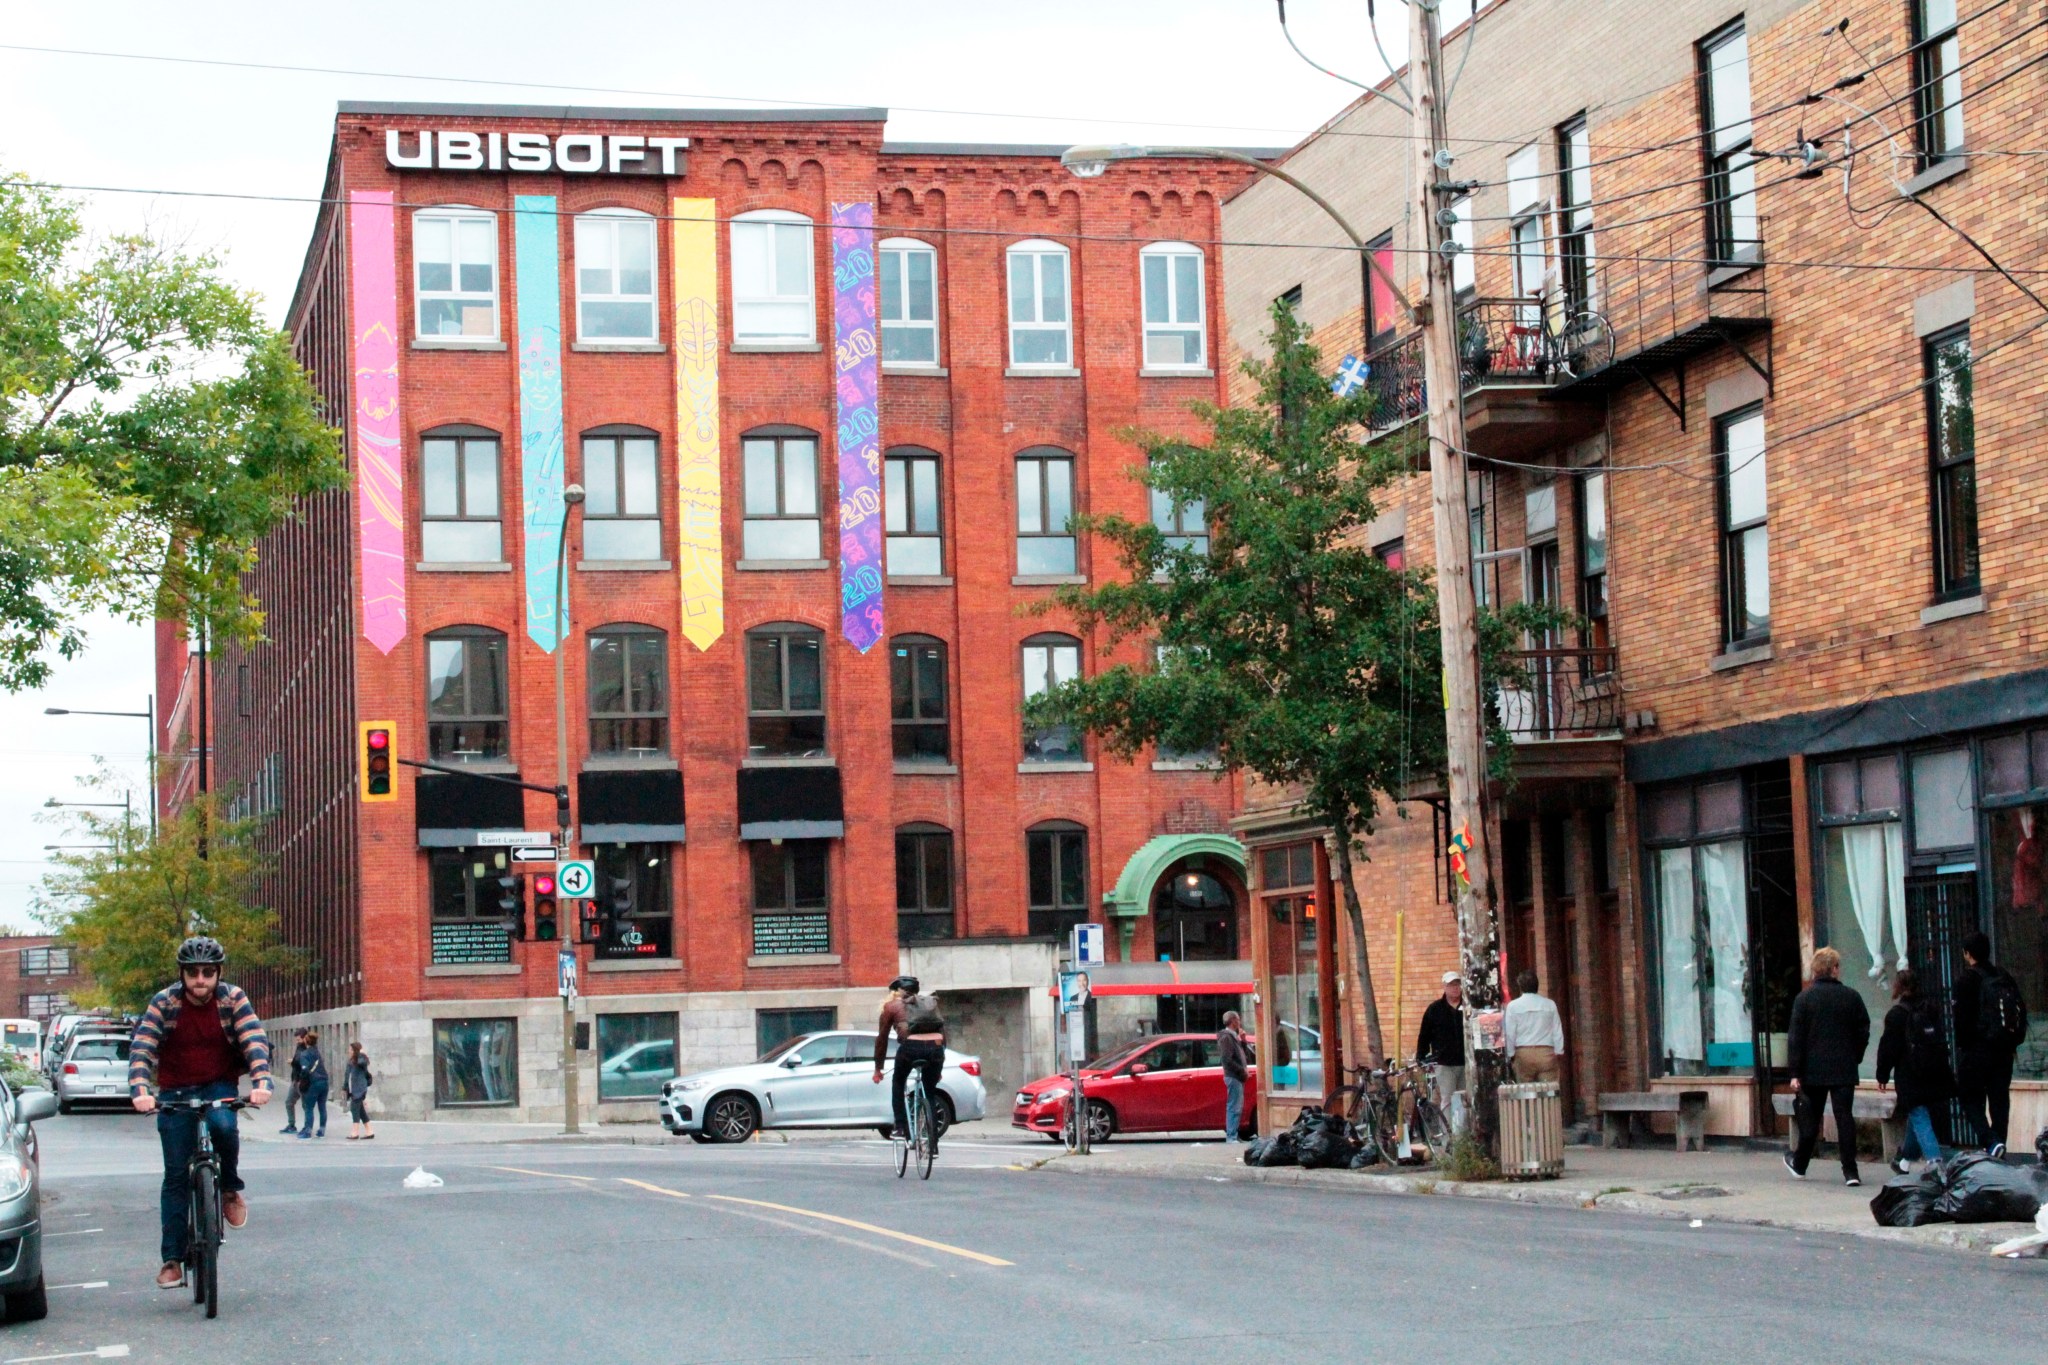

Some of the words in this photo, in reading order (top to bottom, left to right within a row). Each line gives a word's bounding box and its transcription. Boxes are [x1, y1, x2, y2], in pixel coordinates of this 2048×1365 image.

[386, 130, 689, 174] UBISOFT
[836, 249, 874, 292] 20
[836, 329, 876, 371] 20
[838, 407, 878, 451] 20
[840, 486, 880, 530] 20
[842, 565, 882, 609] 20
[481, 836, 533, 844] Saint-Laurent
